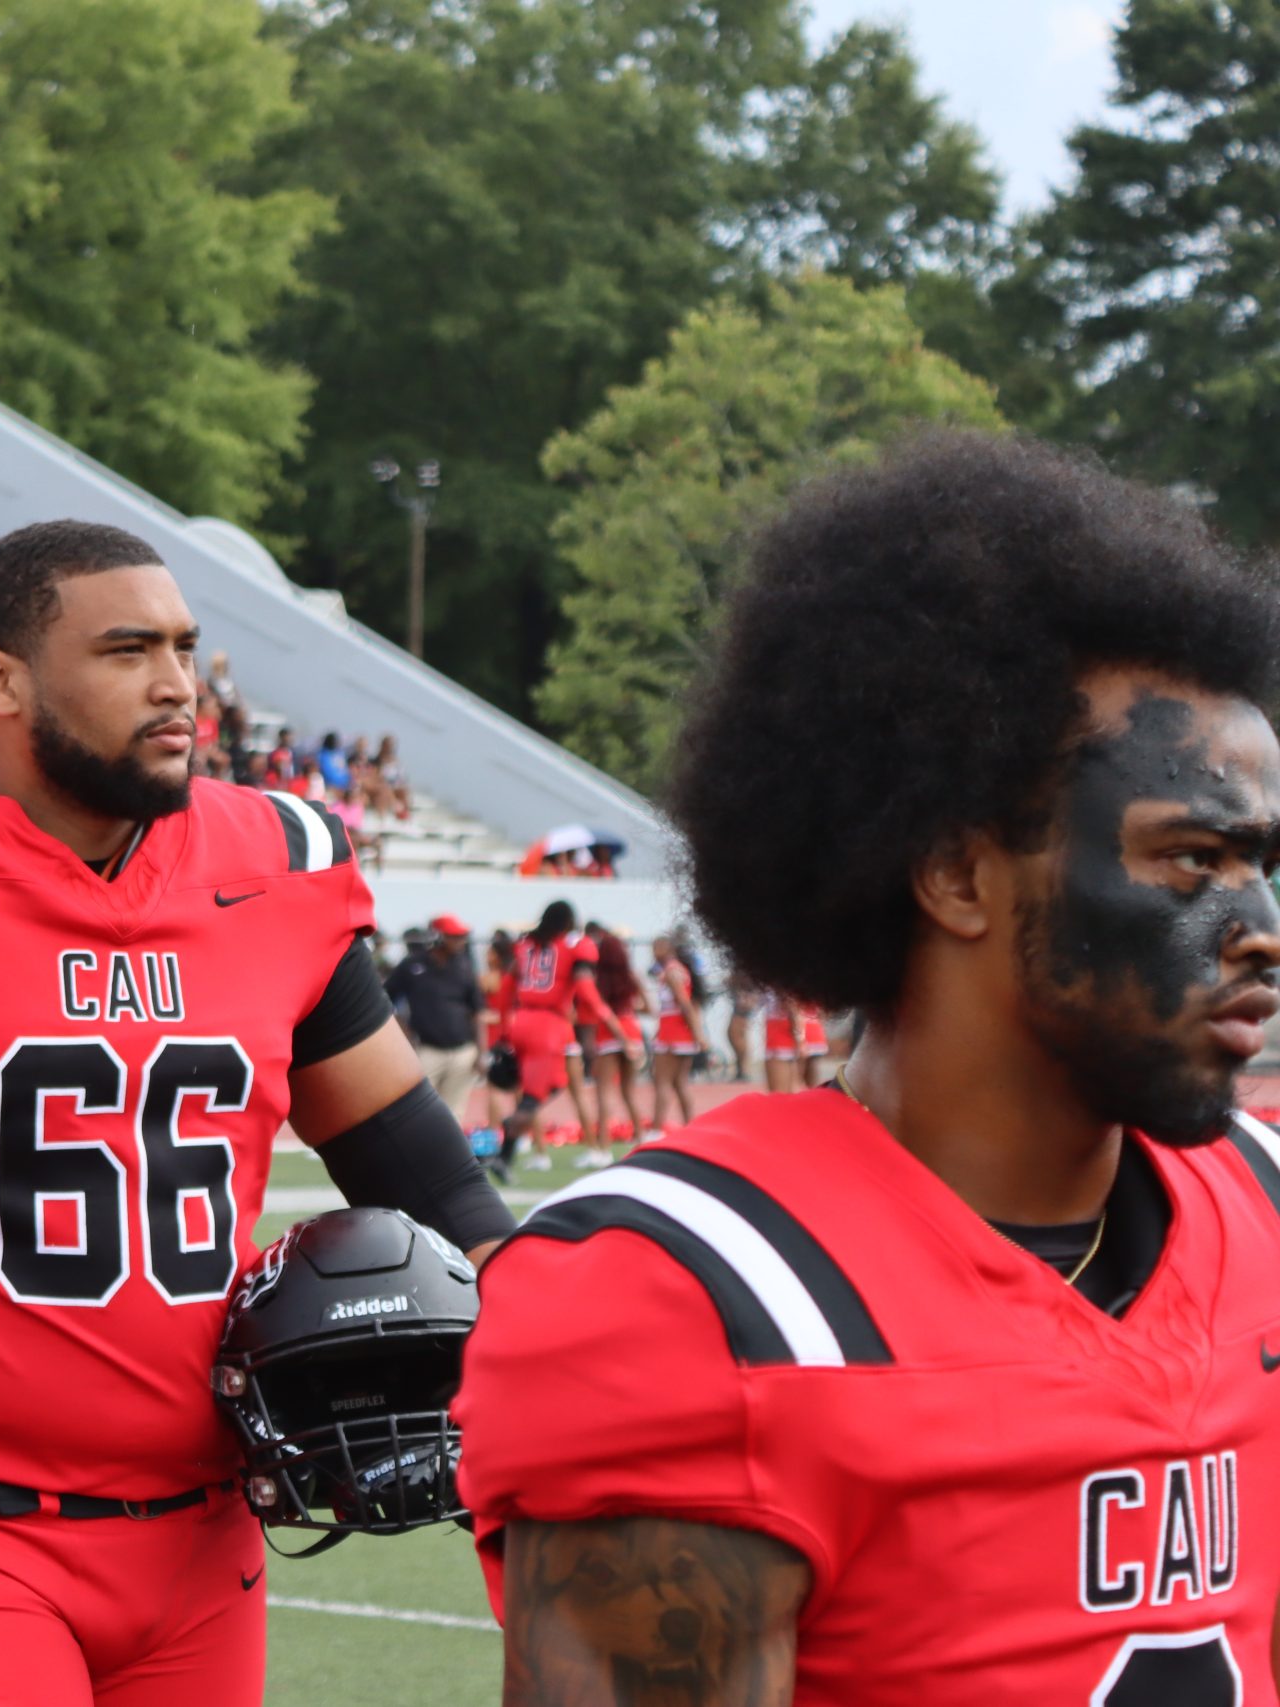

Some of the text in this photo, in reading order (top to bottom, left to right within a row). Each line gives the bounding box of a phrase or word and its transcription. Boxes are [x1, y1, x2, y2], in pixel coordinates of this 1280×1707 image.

[59, 949, 185, 1022] CAU
[330, 1295, 408, 1321] Riddell
[330, 1394, 386, 1412] SPEEDFLEX
[1079, 1450, 1238, 1613] CAU
